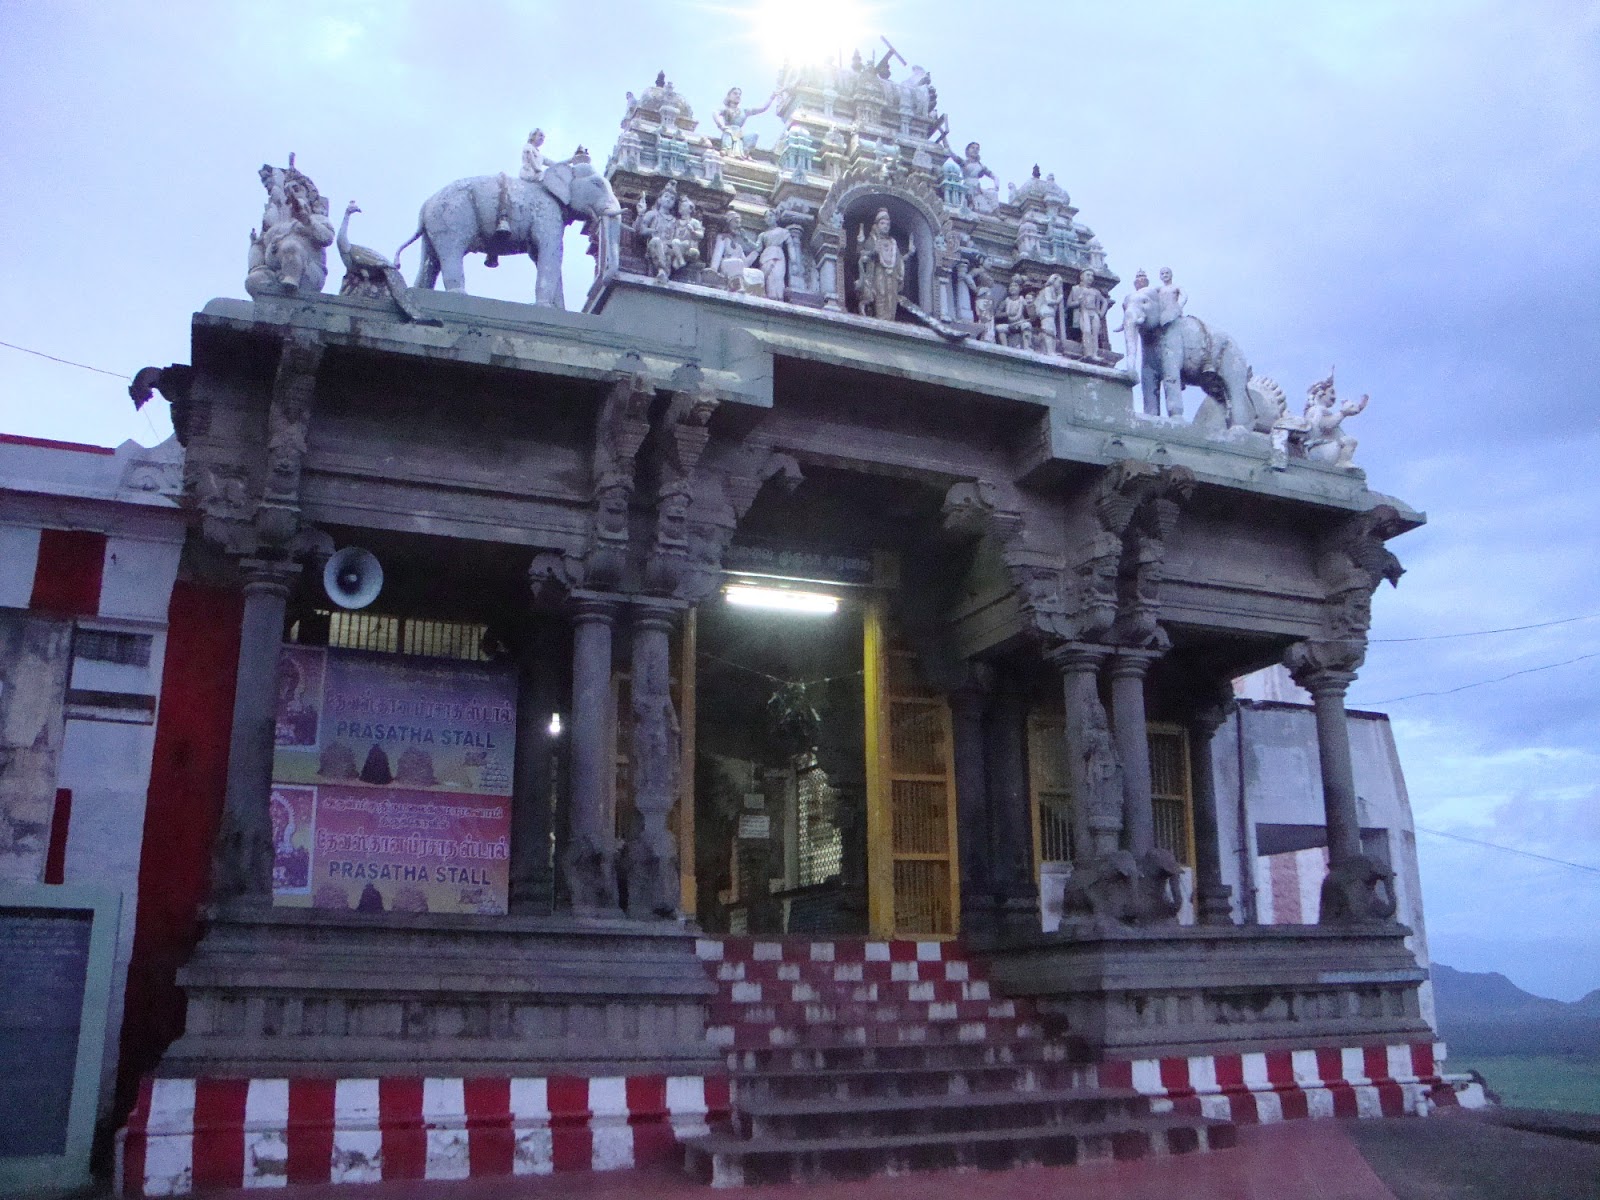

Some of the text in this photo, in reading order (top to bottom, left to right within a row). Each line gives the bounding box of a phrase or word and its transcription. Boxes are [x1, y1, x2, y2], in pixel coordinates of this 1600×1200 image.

[337, 721, 496, 749] PRASATHA STALL
[329, 860, 492, 886] PRASATHA STALL
